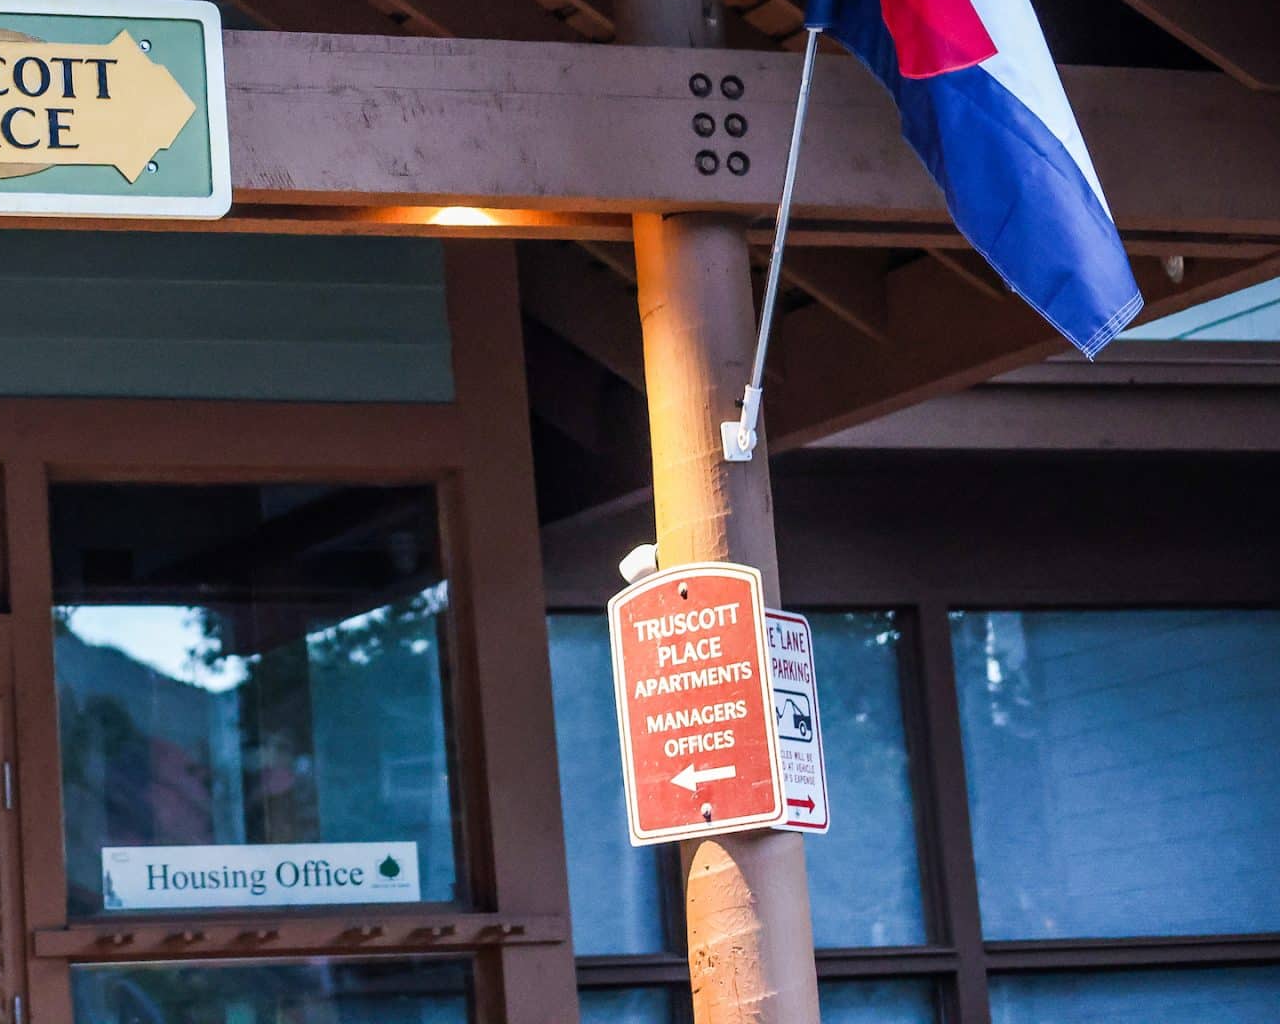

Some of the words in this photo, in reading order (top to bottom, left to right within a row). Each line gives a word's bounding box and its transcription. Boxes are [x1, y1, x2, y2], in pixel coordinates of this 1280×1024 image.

[633, 602, 739, 642] TRUSCOTT
[657, 636, 722, 667] PLACE
[781, 630, 805, 652] LANE
[634, 661, 752, 699] APARTMENTS
[772, 657, 810, 684] PARKING
[646, 700, 747, 734] MANAGERS
[664, 730, 735, 758] OFFICES
[147, 862, 266, 895] Housing
[275, 860, 364, 888] Office
